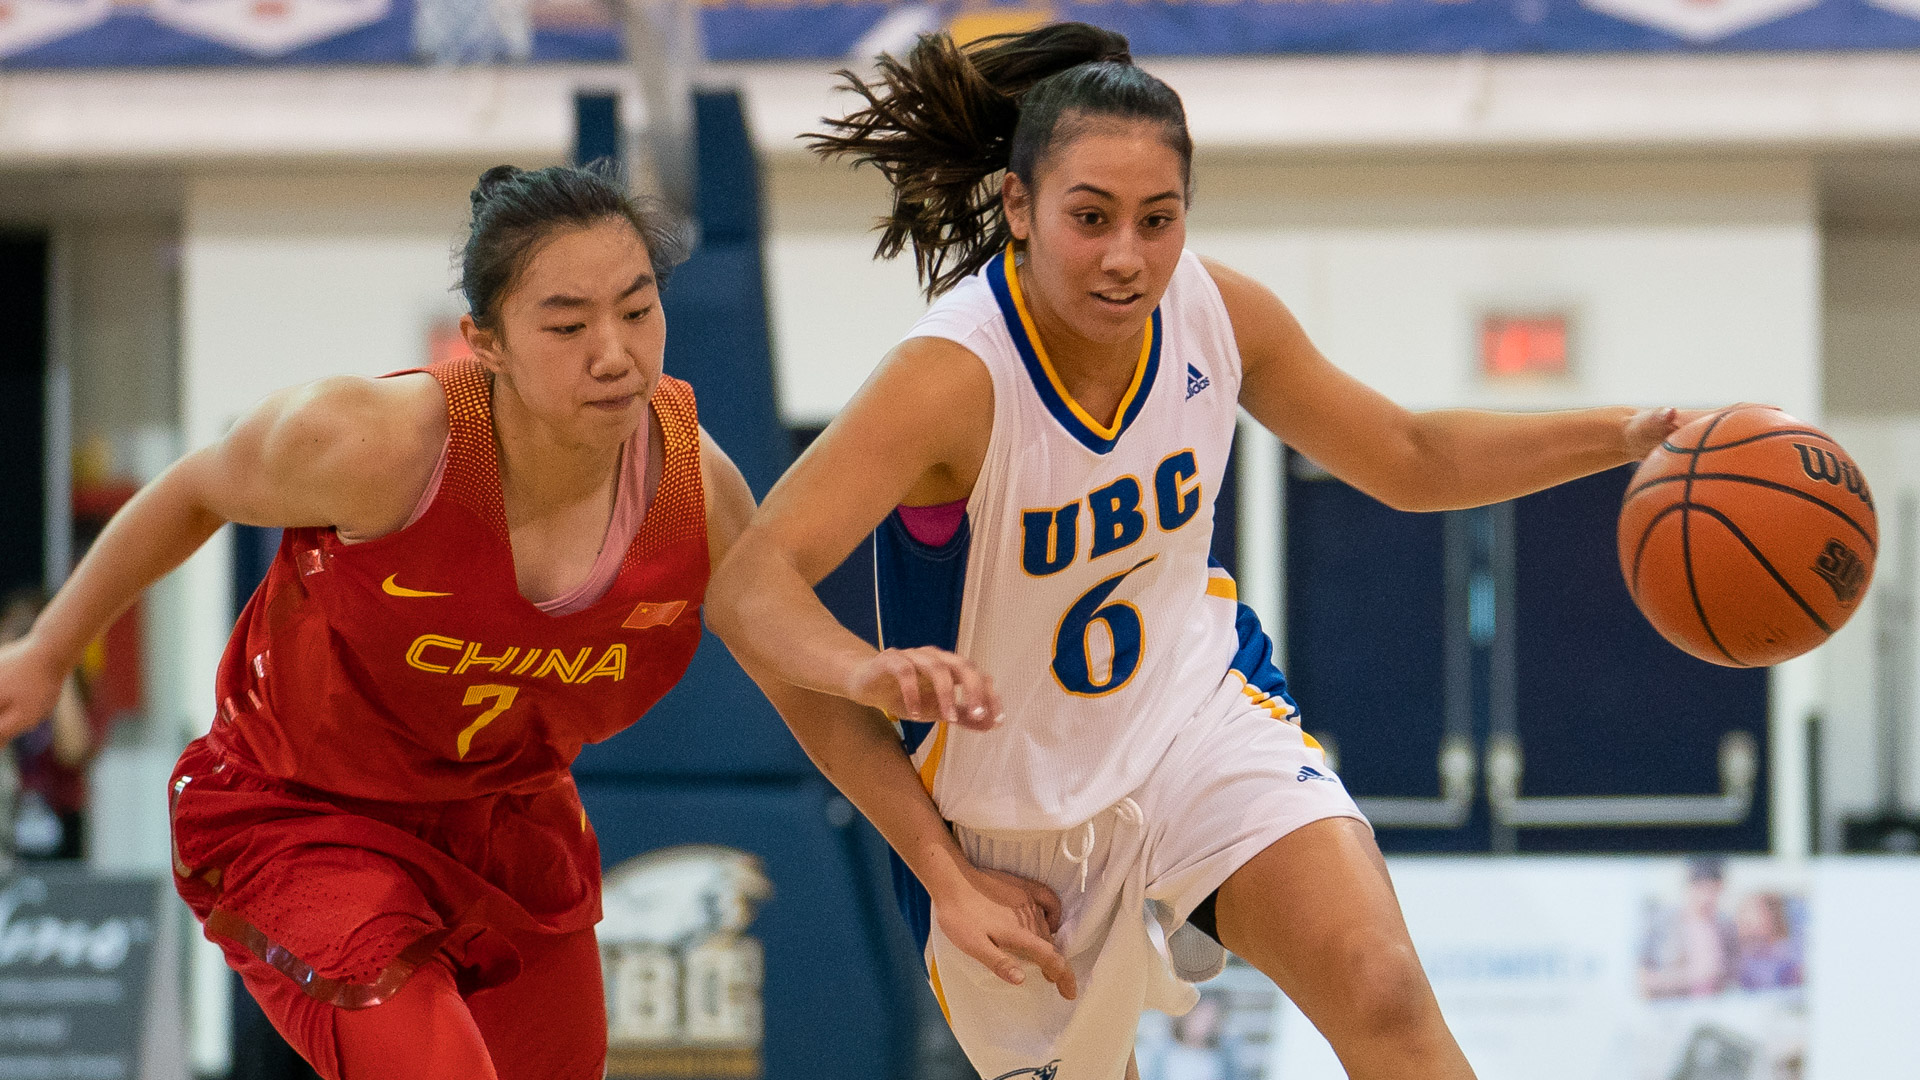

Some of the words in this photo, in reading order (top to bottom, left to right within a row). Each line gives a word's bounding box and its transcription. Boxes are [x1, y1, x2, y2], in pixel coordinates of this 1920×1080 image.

[1020, 448, 1202, 579] UBC
[405, 633, 628, 684] CHINA
[1050, 553, 1160, 699] 6
[457, 684, 520, 760] 7
[600, 940, 766, 1044] BC
